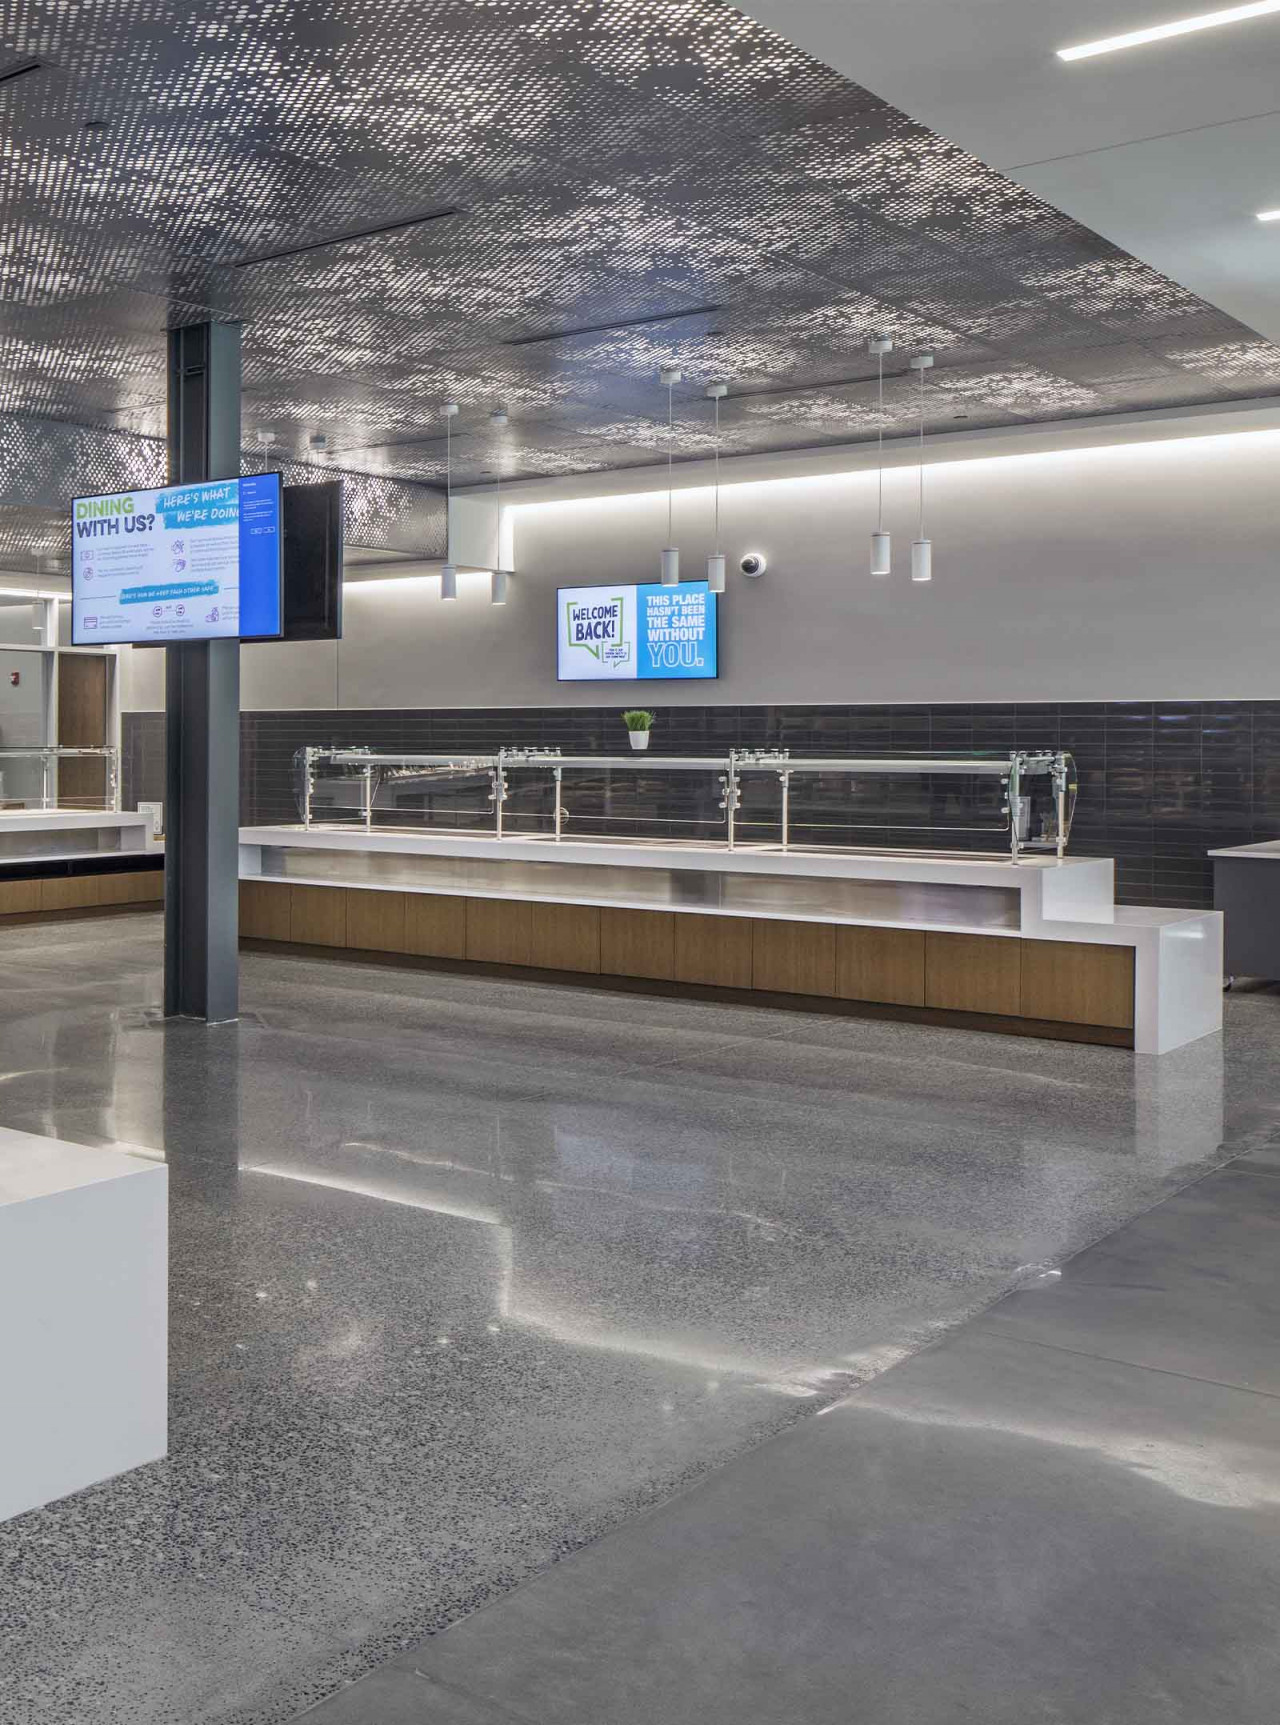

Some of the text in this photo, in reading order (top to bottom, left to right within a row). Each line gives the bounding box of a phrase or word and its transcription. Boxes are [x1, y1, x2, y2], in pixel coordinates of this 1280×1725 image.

[163, 492, 200, 509] HERE'S
[201, 486, 231, 503] WHAT
[76, 496, 135, 520] DINING
[176, 509, 208, 523] WE'RE
[76, 513, 156, 538] WITH US?
[646, 593, 705, 606] THIS PLACE
[572, 604, 618, 621] WELCOME
[681, 604, 705, 615] BEEN
[646, 615, 705, 628] THE SAME
[575, 620, 615, 641] BACK!
[646, 627, 706, 642] WITHOUT
[646, 641, 705, 668] YOU.
